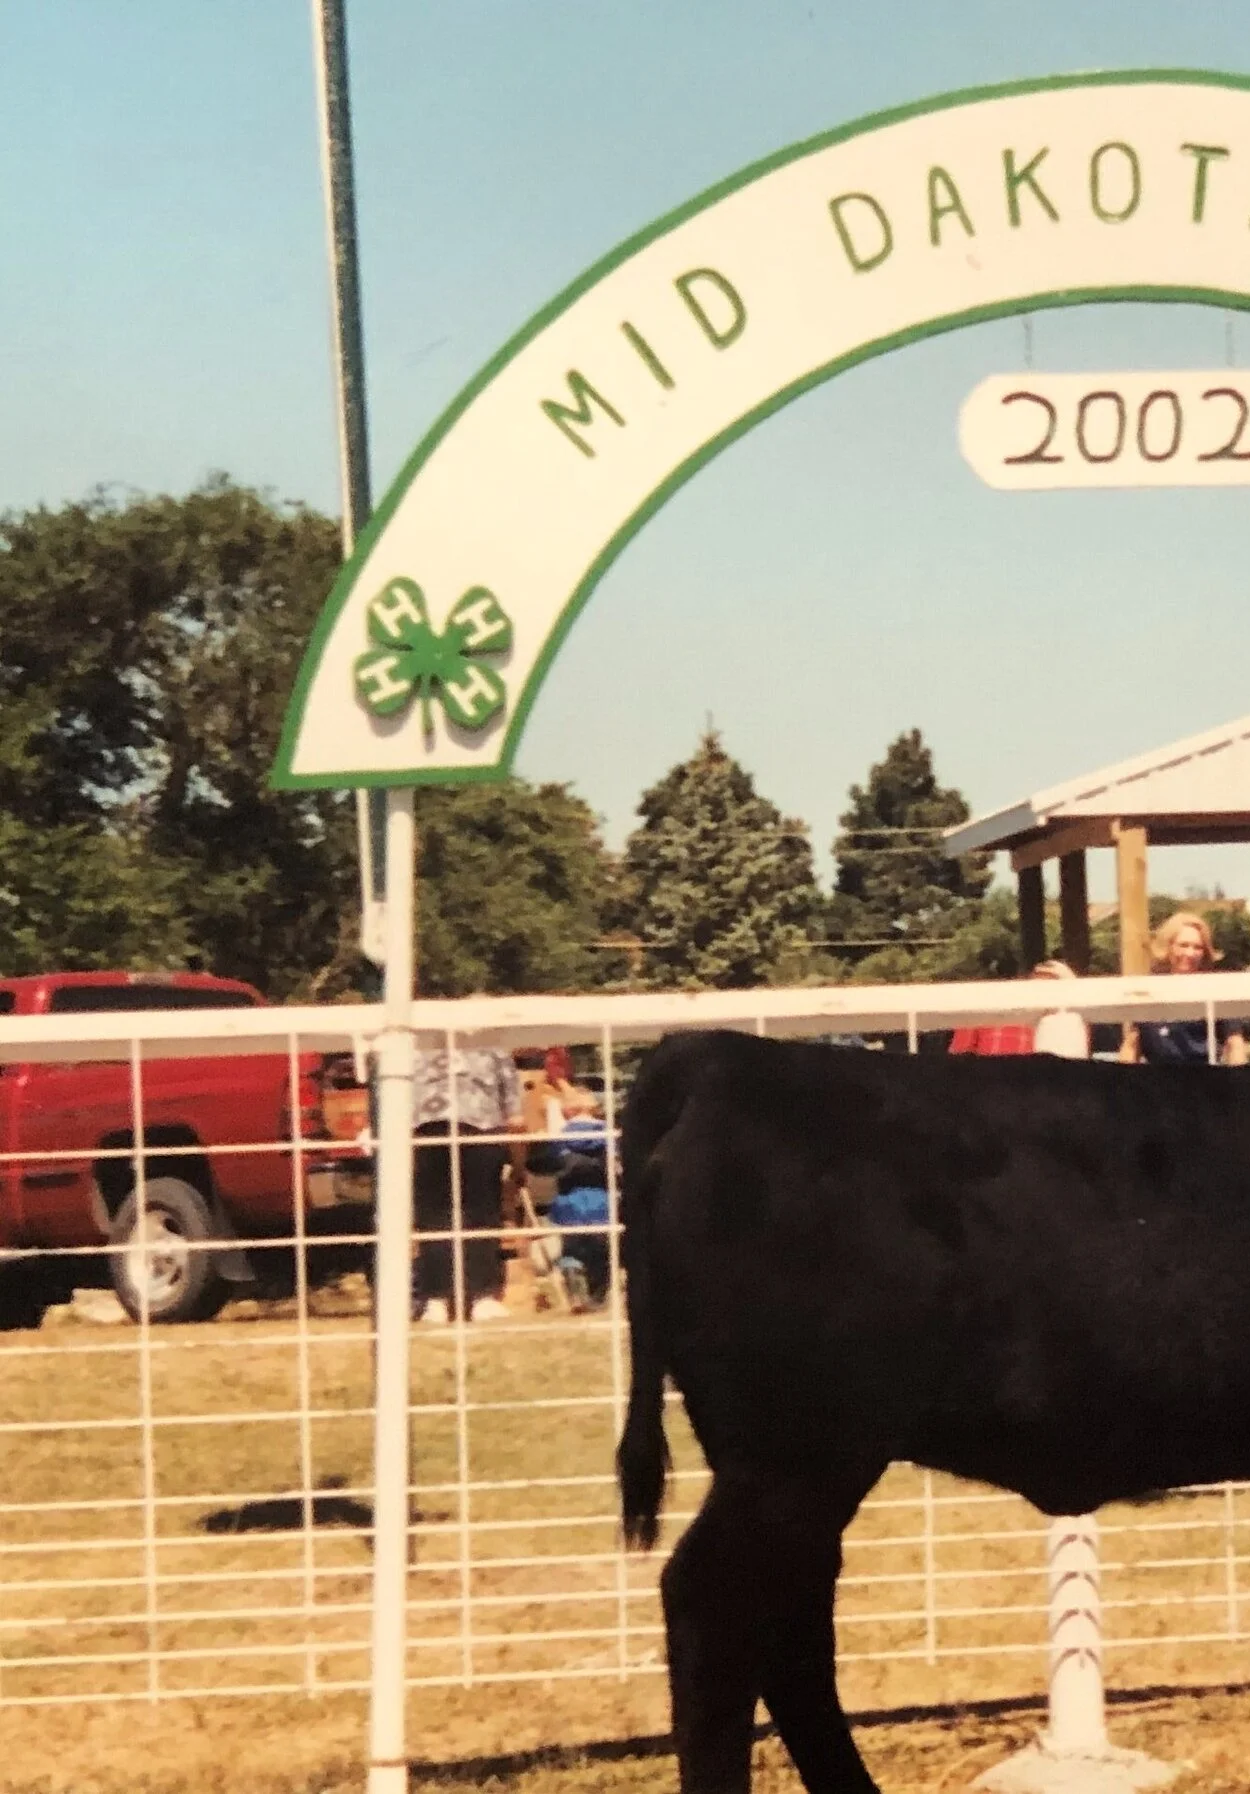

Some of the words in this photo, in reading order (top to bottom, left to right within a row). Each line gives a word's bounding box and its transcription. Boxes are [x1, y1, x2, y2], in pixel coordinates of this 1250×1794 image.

[539, 266, 748, 459] MID
[373, 587, 422, 638] H
[454, 598, 505, 646] H
[359, 656, 411, 702] H
[446, 665, 498, 717] H
